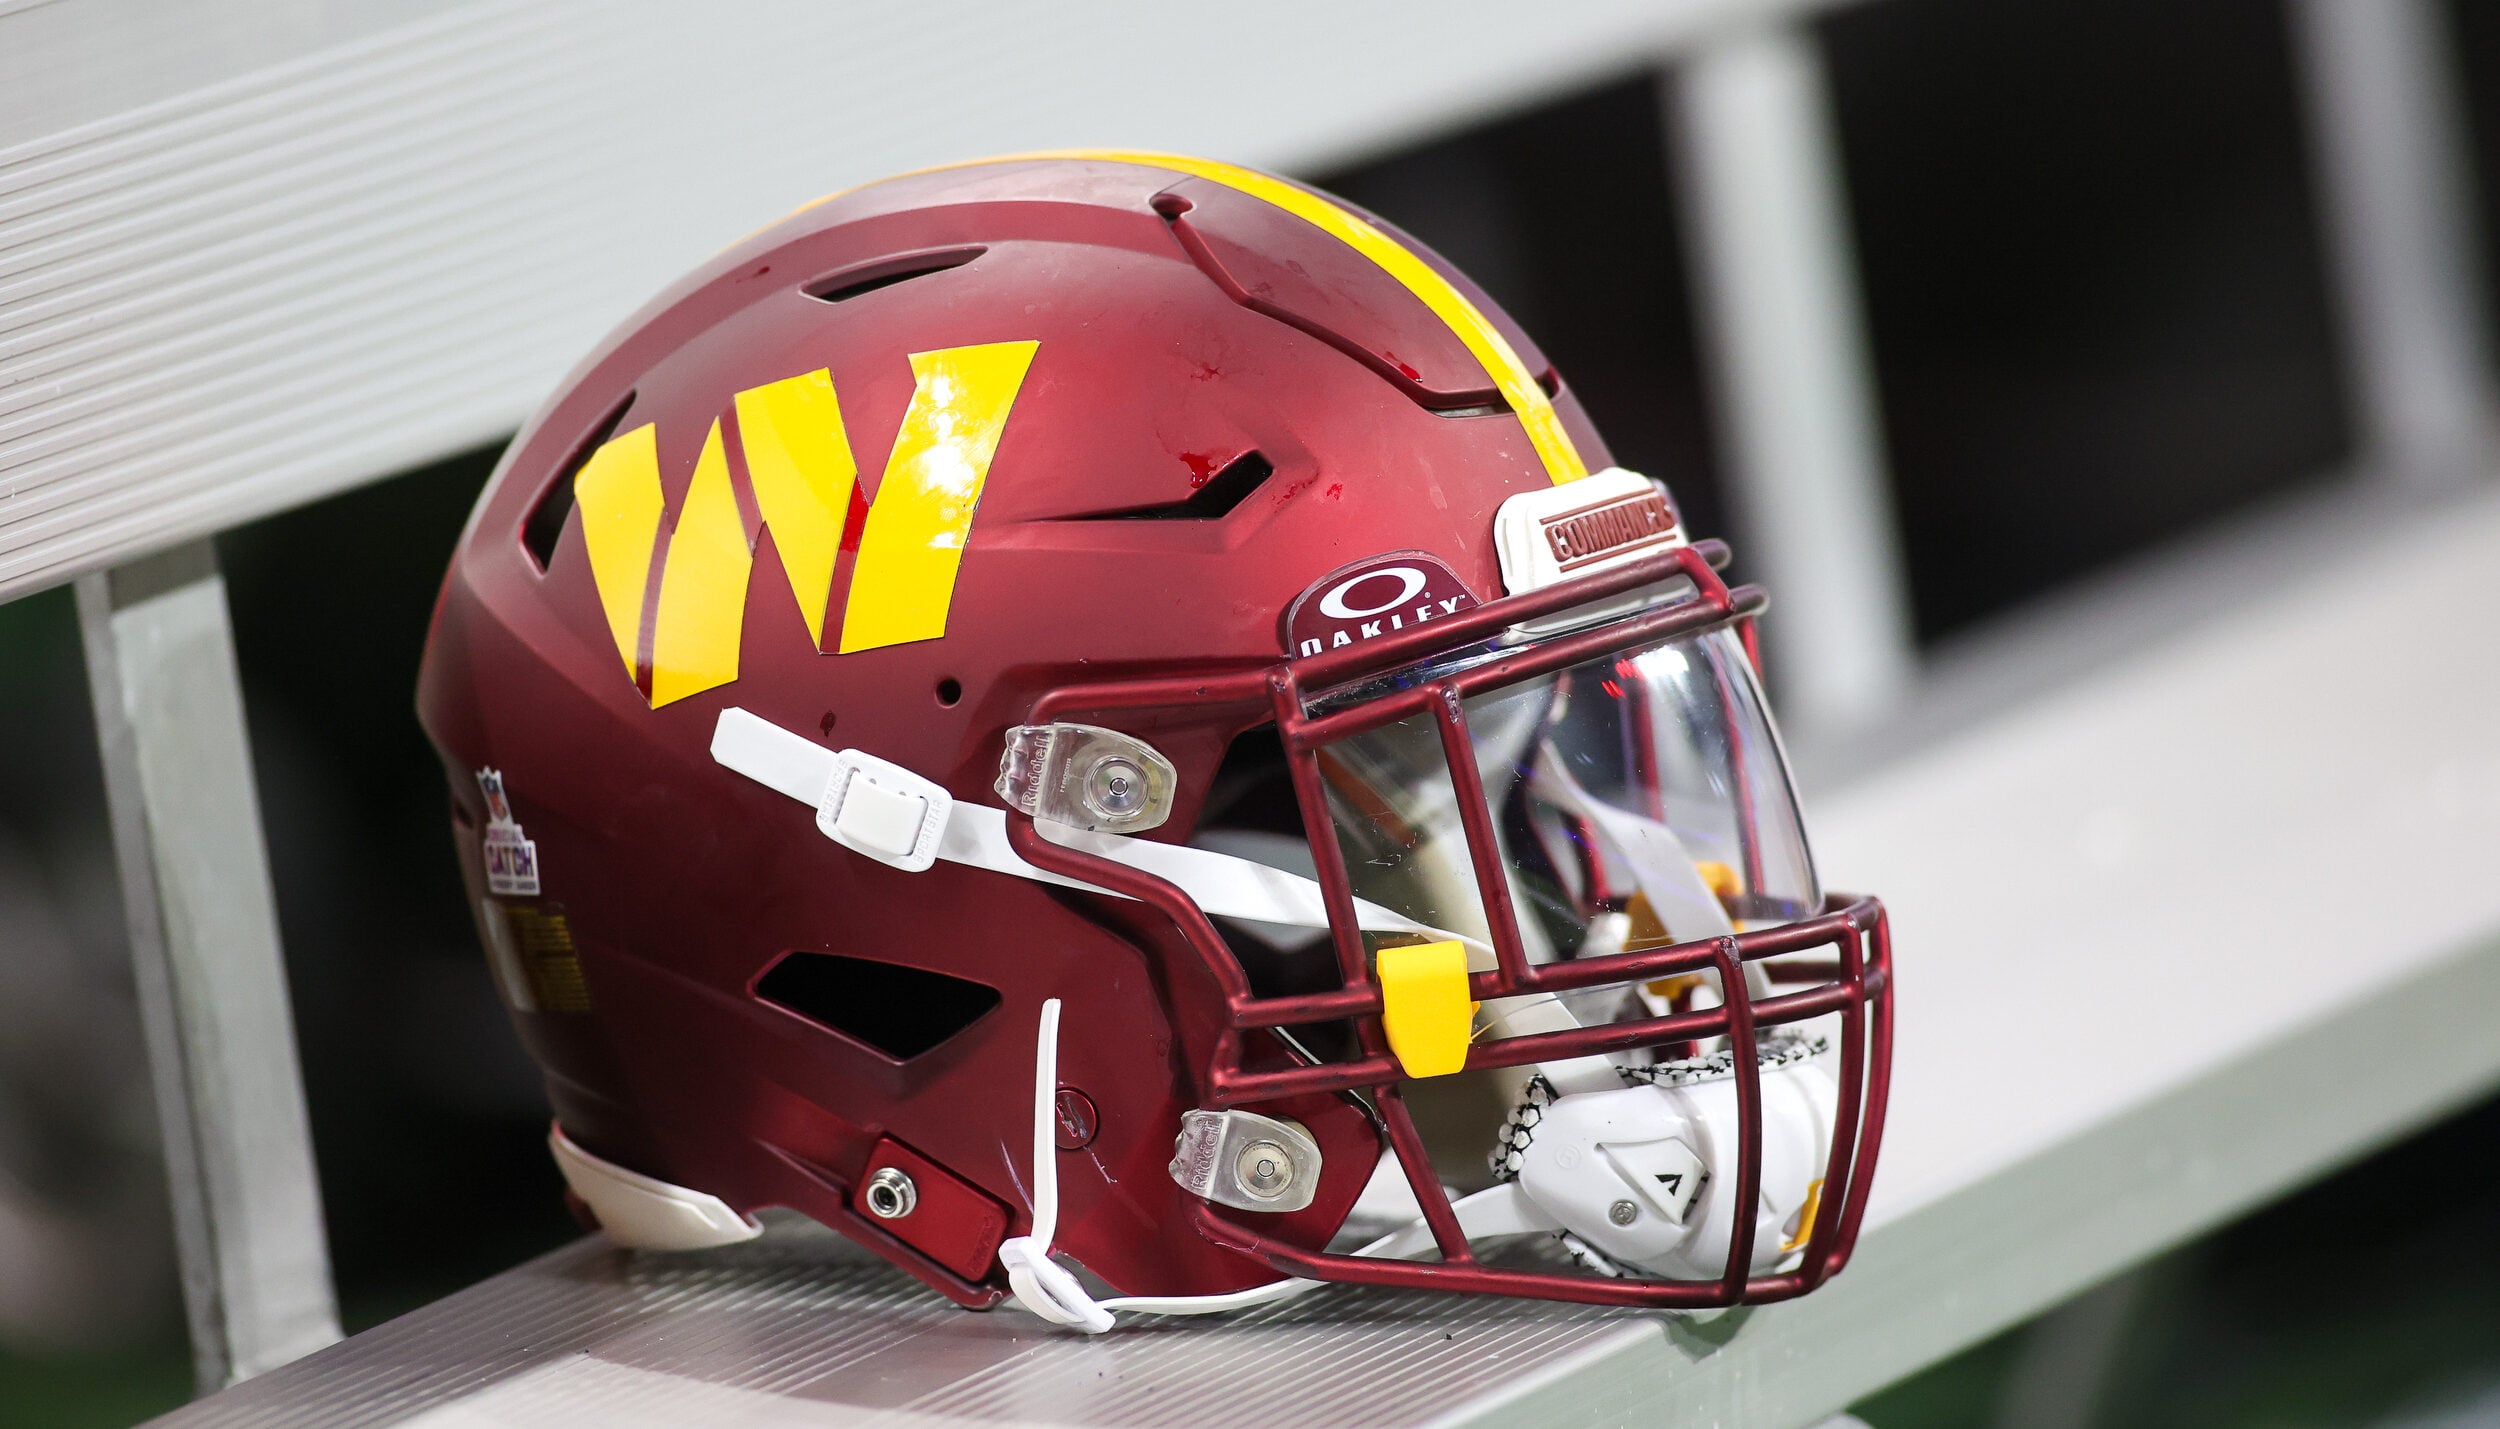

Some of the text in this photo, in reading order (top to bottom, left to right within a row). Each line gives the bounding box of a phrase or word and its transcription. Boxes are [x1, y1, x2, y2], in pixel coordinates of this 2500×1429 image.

[573, 339, 1042, 711] W
[1021, 735, 1051, 808] Riddell
[1190, 1120, 1223, 1191] Riddell
